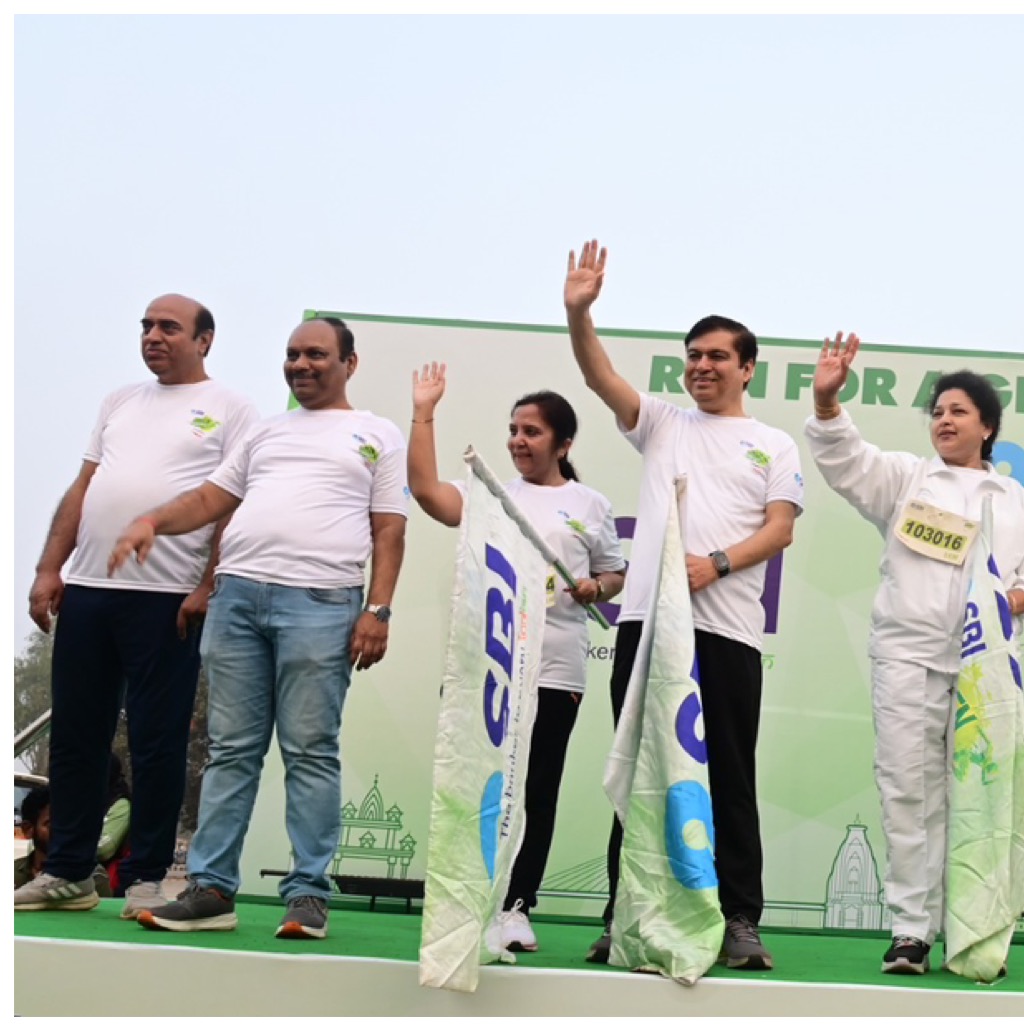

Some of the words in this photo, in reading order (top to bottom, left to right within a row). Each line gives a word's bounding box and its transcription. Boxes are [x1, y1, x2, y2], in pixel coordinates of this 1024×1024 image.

[648, 355, 769, 400] RN
[905, 520, 963, 551] 103016
[483, 542, 516, 747] SBI
